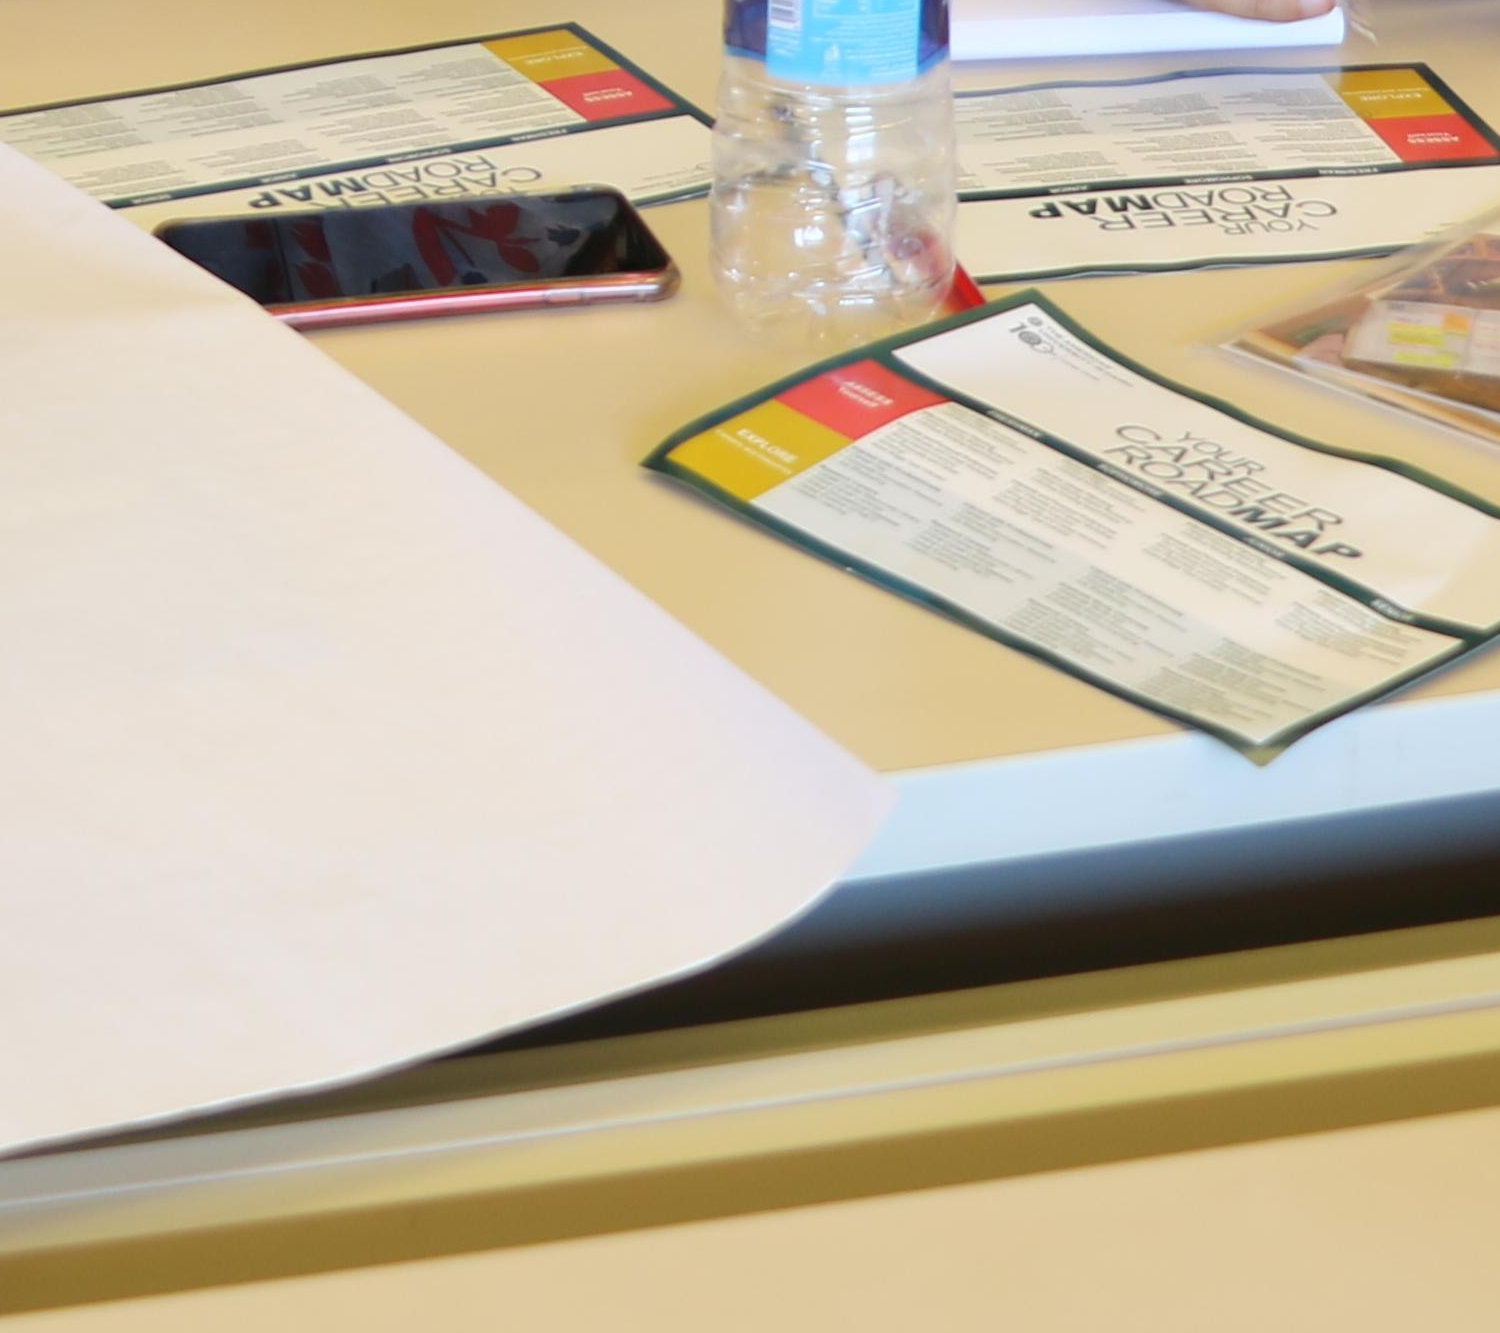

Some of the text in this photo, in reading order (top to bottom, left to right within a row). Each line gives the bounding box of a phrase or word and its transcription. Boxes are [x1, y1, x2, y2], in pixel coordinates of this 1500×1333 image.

[248, 153, 498, 210] ROADMAP
[1028, 185, 1294, 220] ROADMAP
[1088, 199, 1337, 233] CAREER
[1223, 218, 1321, 235] YOUR
[736, 427, 799, 464] EXPLORE
[1177, 431, 1266, 475] YOUR
[1116, 424, 1344, 532] CAREER
[1105, 445, 1363, 559] ROADMAP
